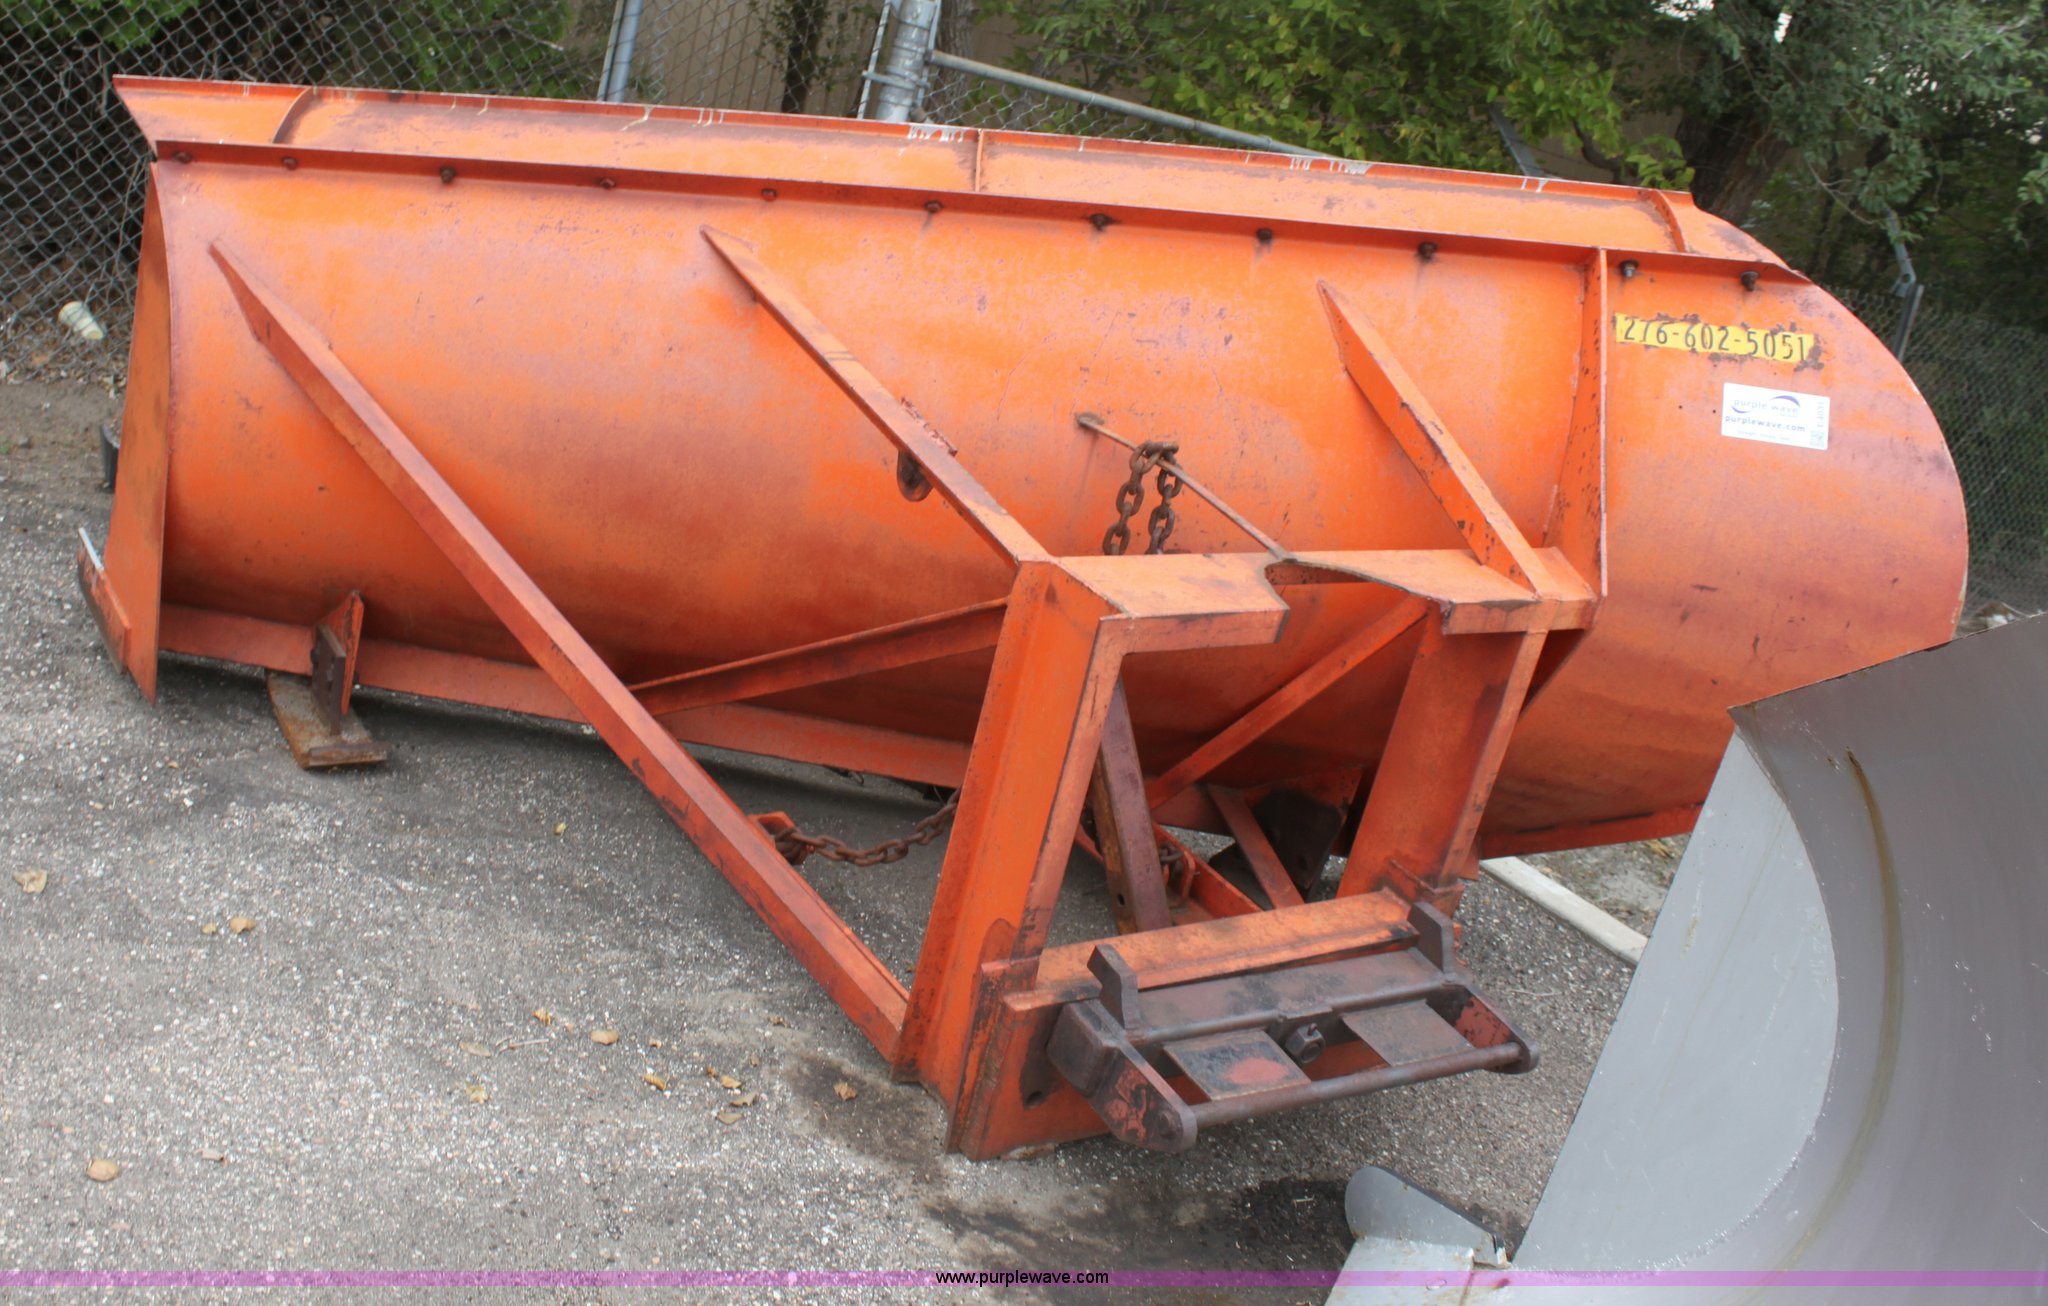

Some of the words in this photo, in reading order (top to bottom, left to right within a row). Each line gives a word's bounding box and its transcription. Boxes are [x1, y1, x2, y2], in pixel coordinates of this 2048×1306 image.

[1624, 315, 1806, 362] 276-602-5051
[1734, 399, 1767, 409] purple
[1771, 405, 1798, 413] wave
[1725, 415, 1805, 432] purplewave.com
